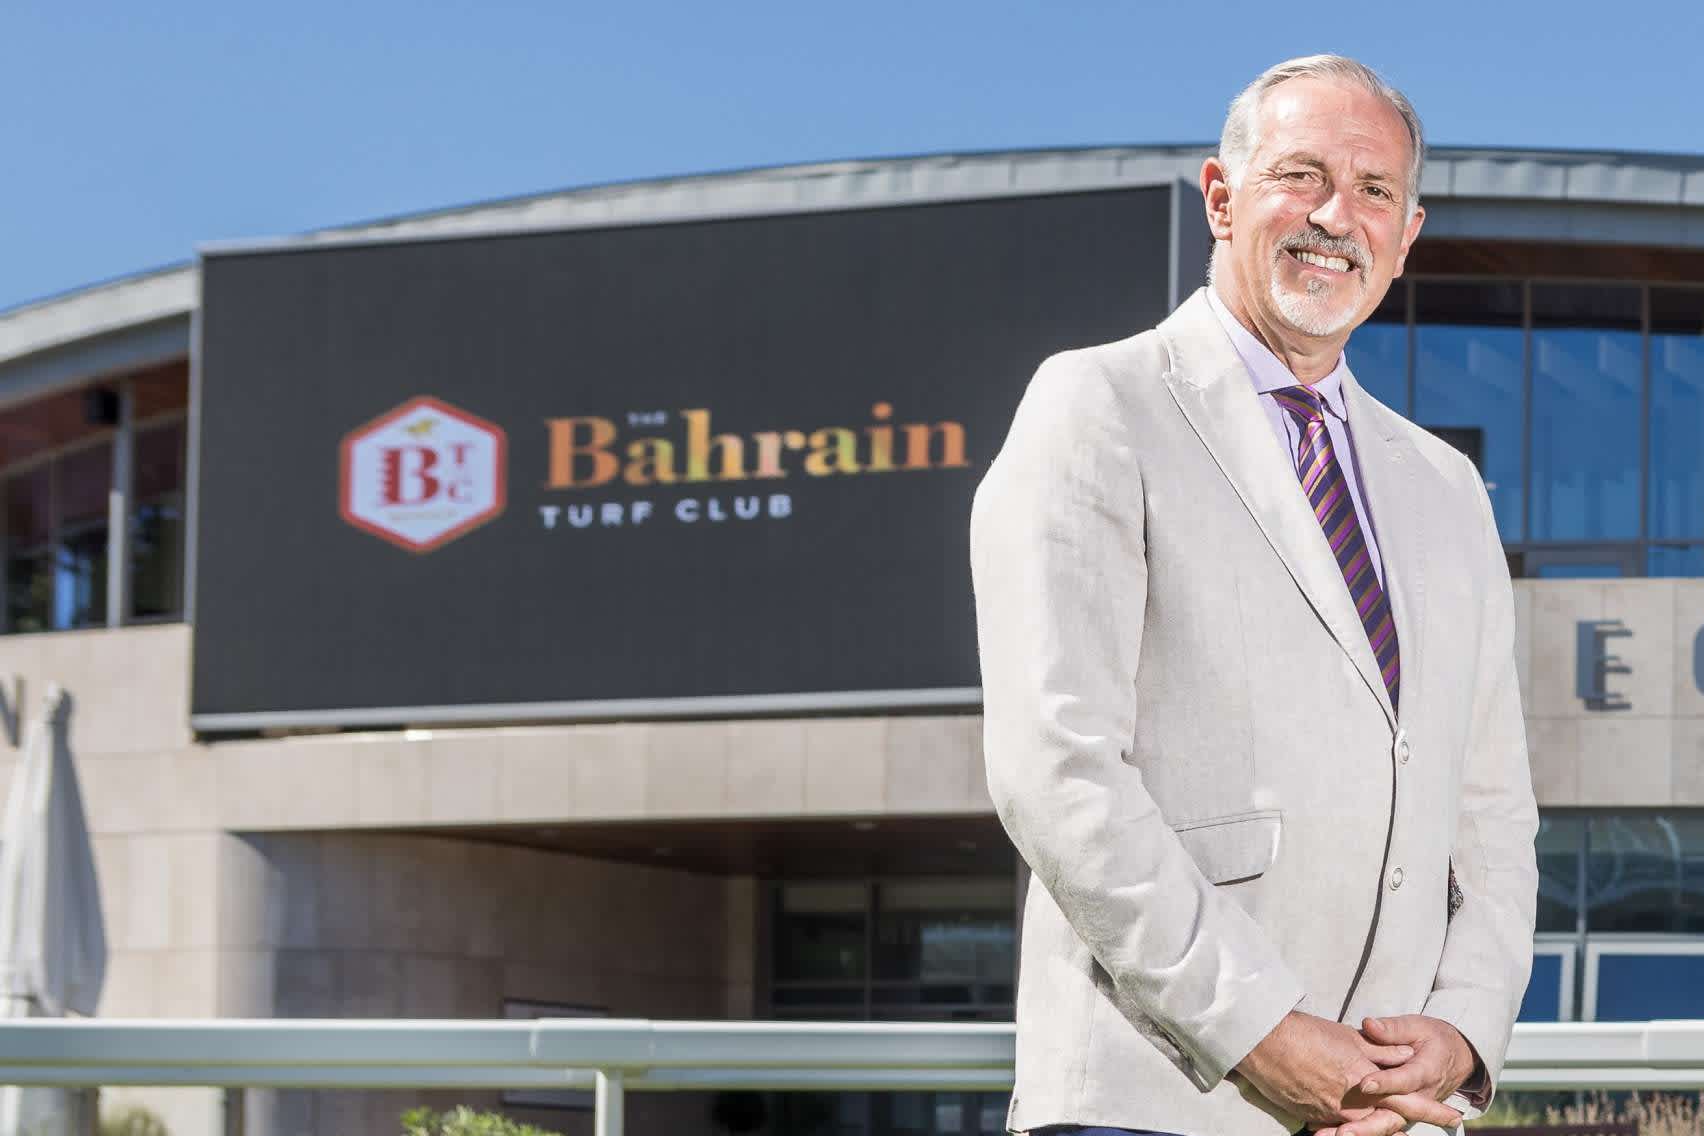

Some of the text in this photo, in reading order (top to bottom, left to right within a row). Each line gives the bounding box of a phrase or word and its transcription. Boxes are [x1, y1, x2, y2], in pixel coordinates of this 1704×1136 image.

[543, 402, 971, 491] Bahrain
[539, 494, 793, 529] TURF CLUB
